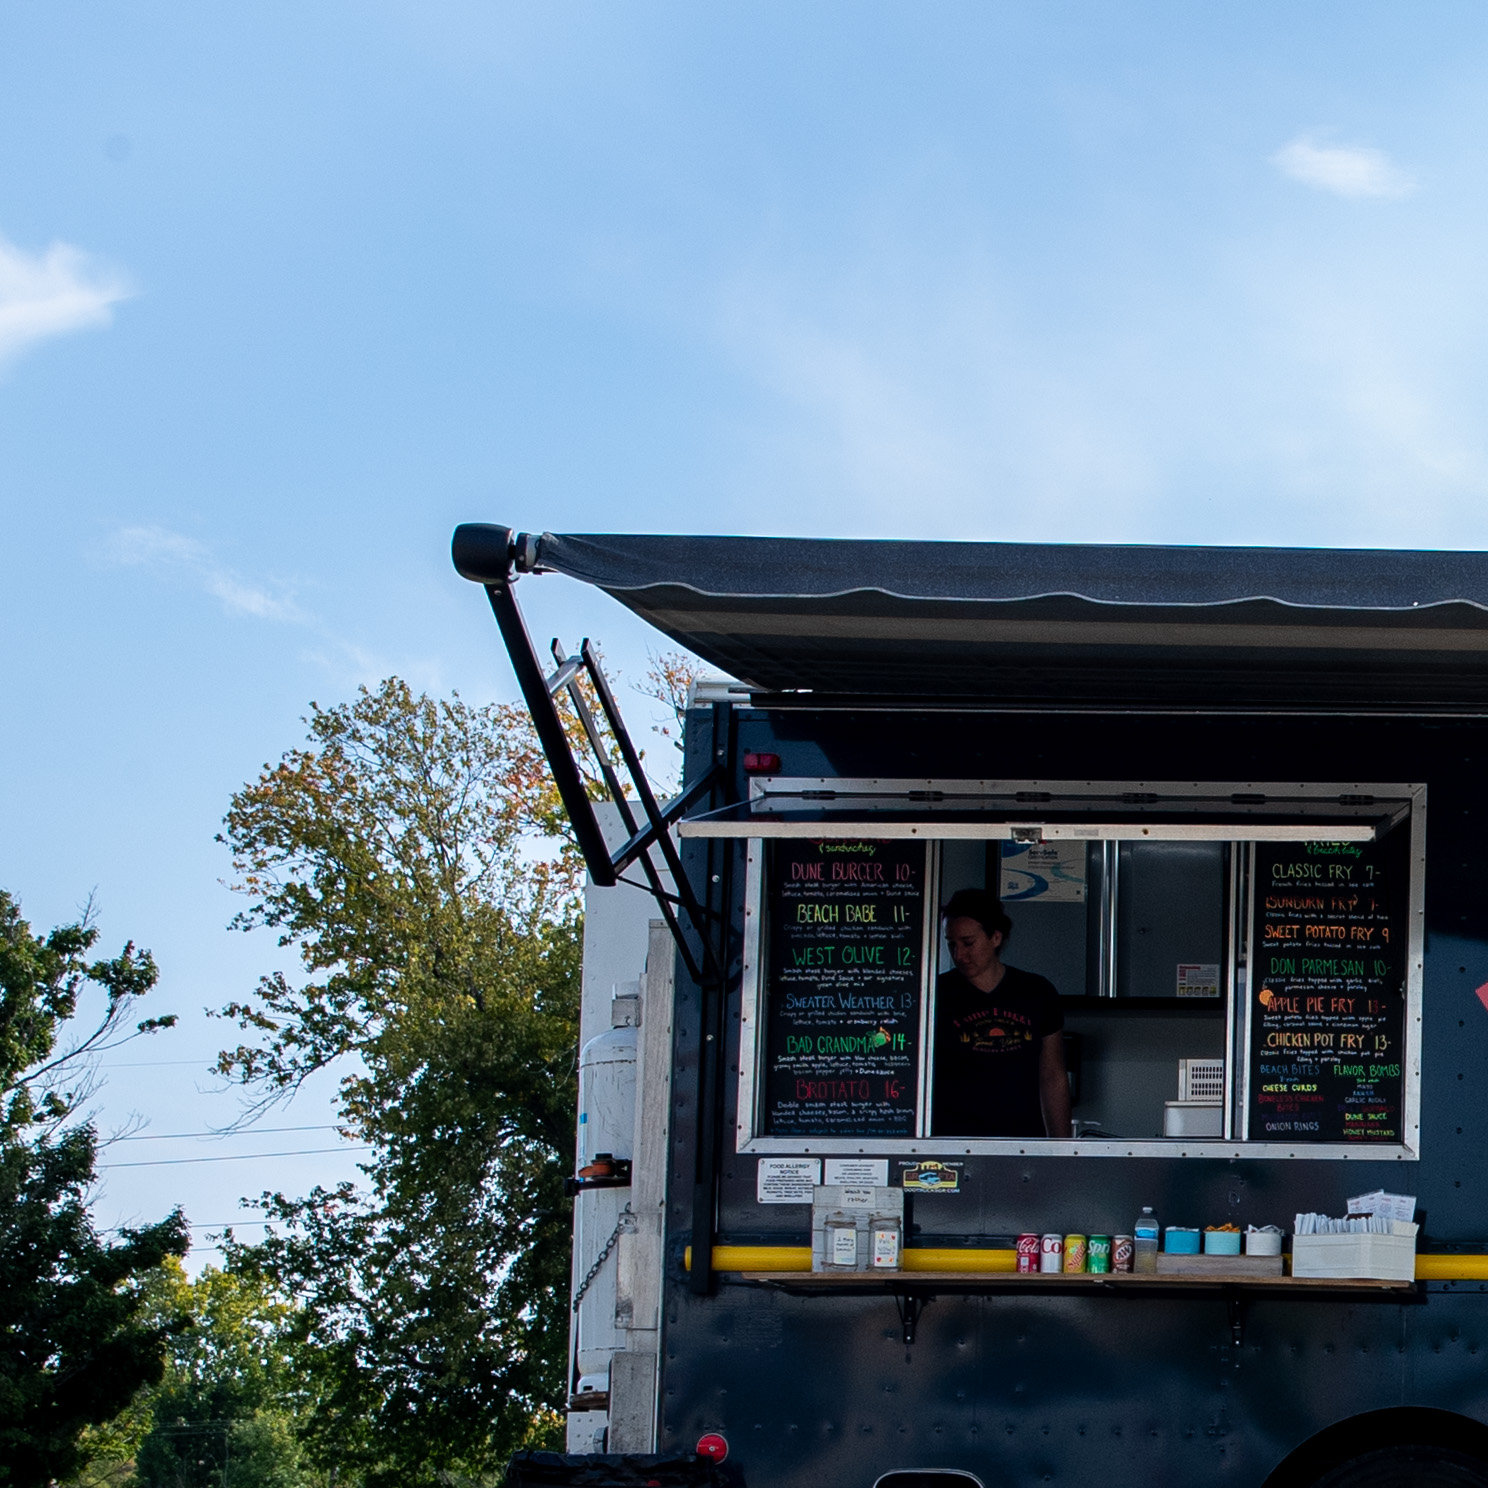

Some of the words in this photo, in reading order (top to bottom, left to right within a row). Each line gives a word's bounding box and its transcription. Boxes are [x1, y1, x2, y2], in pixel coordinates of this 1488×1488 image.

[792, 862, 825, 881] DUNE
[832, 862, 885, 882] BURGER
[1272, 863, 1322, 879] CLASSIC
[1329, 863, 1354, 880] FRY
[797, 903, 839, 923] BEACH
[845, 904, 877, 923] BABE
[1270, 896, 1324, 910] SUNBURN
[1331, 897, 1353, 912] FRY
[1264, 924, 1301, 939] SWEET
[1305, 924, 1346, 940] POTATO
[1350, 926, 1375, 941] FRY
[1381, 927, 1390, 944] 9
[792, 946, 836, 966] WEST
[842, 946, 885, 965] OLIVE
[1270, 957, 1295, 975] DON
[1302, 958, 1364, 976] PARMESAN
[786, 992, 836, 1010] SWEATER
[838, 992, 896, 1010] WEATHER
[1267, 996, 1300, 1014] APPLE
[1306, 996, 1325, 1013] PIE
[1331, 997, 1356, 1014] FRY
[787, 1035, 813, 1054] BAD
[817, 1035, 876, 1054] GRANDMA
[1267, 1032, 1311, 1048] CHICKEN
[1314, 1033, 1335, 1047] POT
[1340, 1033, 1365, 1049] FRY
[1260, 1064, 1289, 1076] BEACH
[1291, 1064, 1321, 1077] BITES
[1333, 1064, 1366, 1077] FLAVOR
[1369, 1064, 1400, 1078] BOMBS
[796, 1079, 870, 1100] BROTATO
[1262, 1083, 1288, 1092] CHEESE
[1291, 1083, 1318, 1092] CURDS
[1265, 1122, 1291, 1131] ONION
[1294, 1121, 1321, 1132] RINGS
